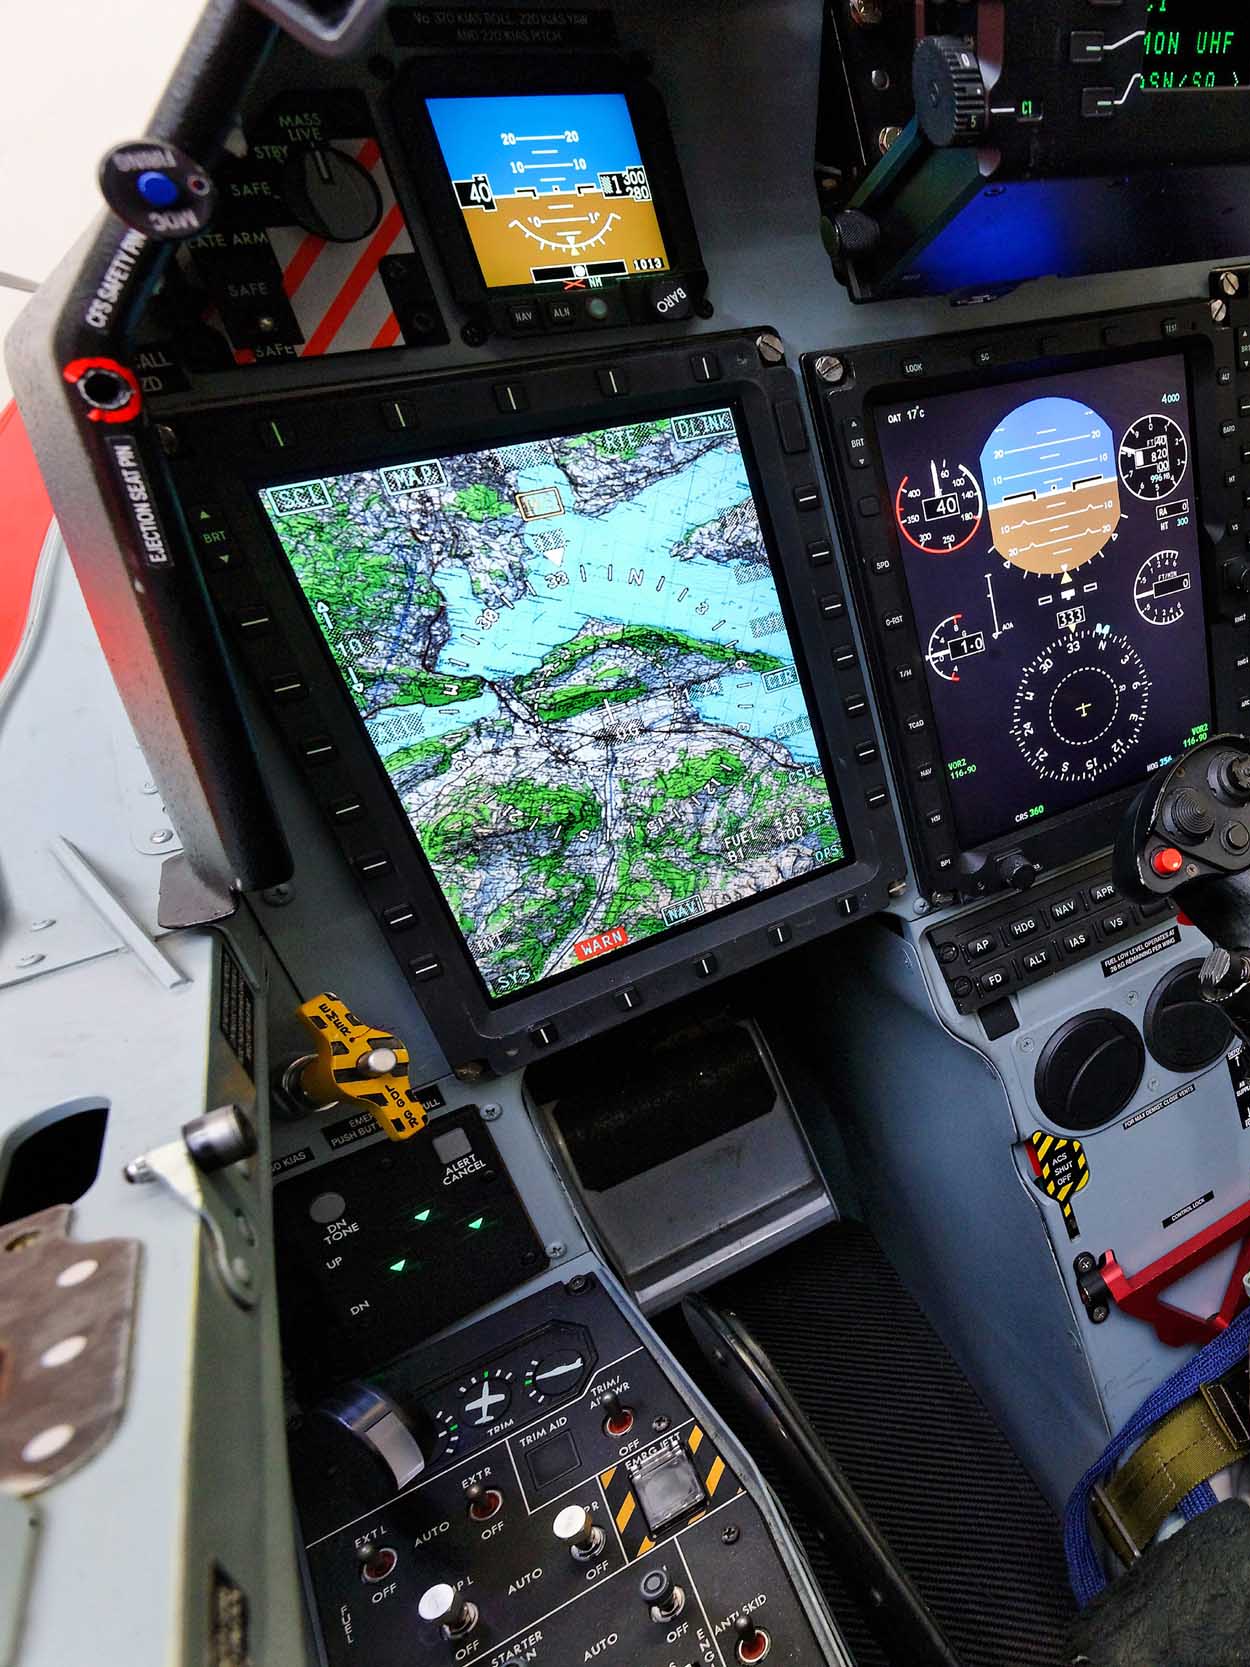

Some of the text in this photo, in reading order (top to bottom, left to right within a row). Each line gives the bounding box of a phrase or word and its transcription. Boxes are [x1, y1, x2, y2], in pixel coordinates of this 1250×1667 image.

[1197, 31, 1234, 53] UHF
[279, 114, 321, 127] MASS
[288, 128, 320, 141] LIVE
[501, 131, 579, 145] 20 20
[254, 146, 288, 159] STBY
[510, 159, 586, 173] 10 10
[231, 183, 271, 196] SAFE
[470, 185, 490, 203] 40
[633, 258, 662, 270] 1013
[228, 283, 267, 297] SAFE
[656, 287, 687, 313] BARO
[515, 311, 532, 321] NAV
[1161, 393, 1180, 403] 4000
[393, 465, 432, 488] MAP
[604, 429, 637, 449] RTE
[678, 415, 729, 436] DLINK
[851, 438, 864, 448] BRT
[121, 470, 146, 502] SEAT
[936, 497, 956, 514] 40
[131, 503, 167, 563] EJECTION
[1059, 608, 1084, 626] 333
[948, 758, 967, 771] VOR2
[807, 811, 831, 827] STS
[1015, 805, 1044, 822] CRS 360
[815, 846, 839, 861] OPS
[976, 886, 1113, 952] AP HDG NAV APR
[581, 931, 623, 956] WARN
[989, 918, 1123, 986] FD ALT IAS VS
[1129, 945, 1144, 955] LEVEL
[498, 968, 530, 988] SYS
[318, 1002, 351, 1040] EMER
[385, 1084, 418, 1128] LDG GR
[446, 1154, 477, 1176] ALERT
[1053, 1153, 1067, 1166] ACS
[442, 1159, 486, 1186] CANCEL
[1055, 1161, 1072, 1176] SHUT
[1057, 1173, 1072, 1185] OFF
[327, 1219, 347, 1232] DN
[324, 1223, 360, 1246] TONE
[326, 1256, 342, 1270] UP
[351, 1301, 370, 1315] DN
[487, 1419, 514, 1436] TRIM
[519, 1416, 567, 1448] TRIM AID
[619, 1439, 640, 1456] OFF
[414, 1521, 505, 1548] AUTO OFF
[586, 1561, 608, 1580] OFF
[507, 1567, 543, 1595] AUTO
[372, 1583, 397, 1604] OFF
[714, 1594, 767, 1636] ANTI SKID
[455, 1640, 479, 1661] OFF
[491, 1631, 543, 1667] STARTER
[583, 1623, 689, 1663] AUTO OFF
